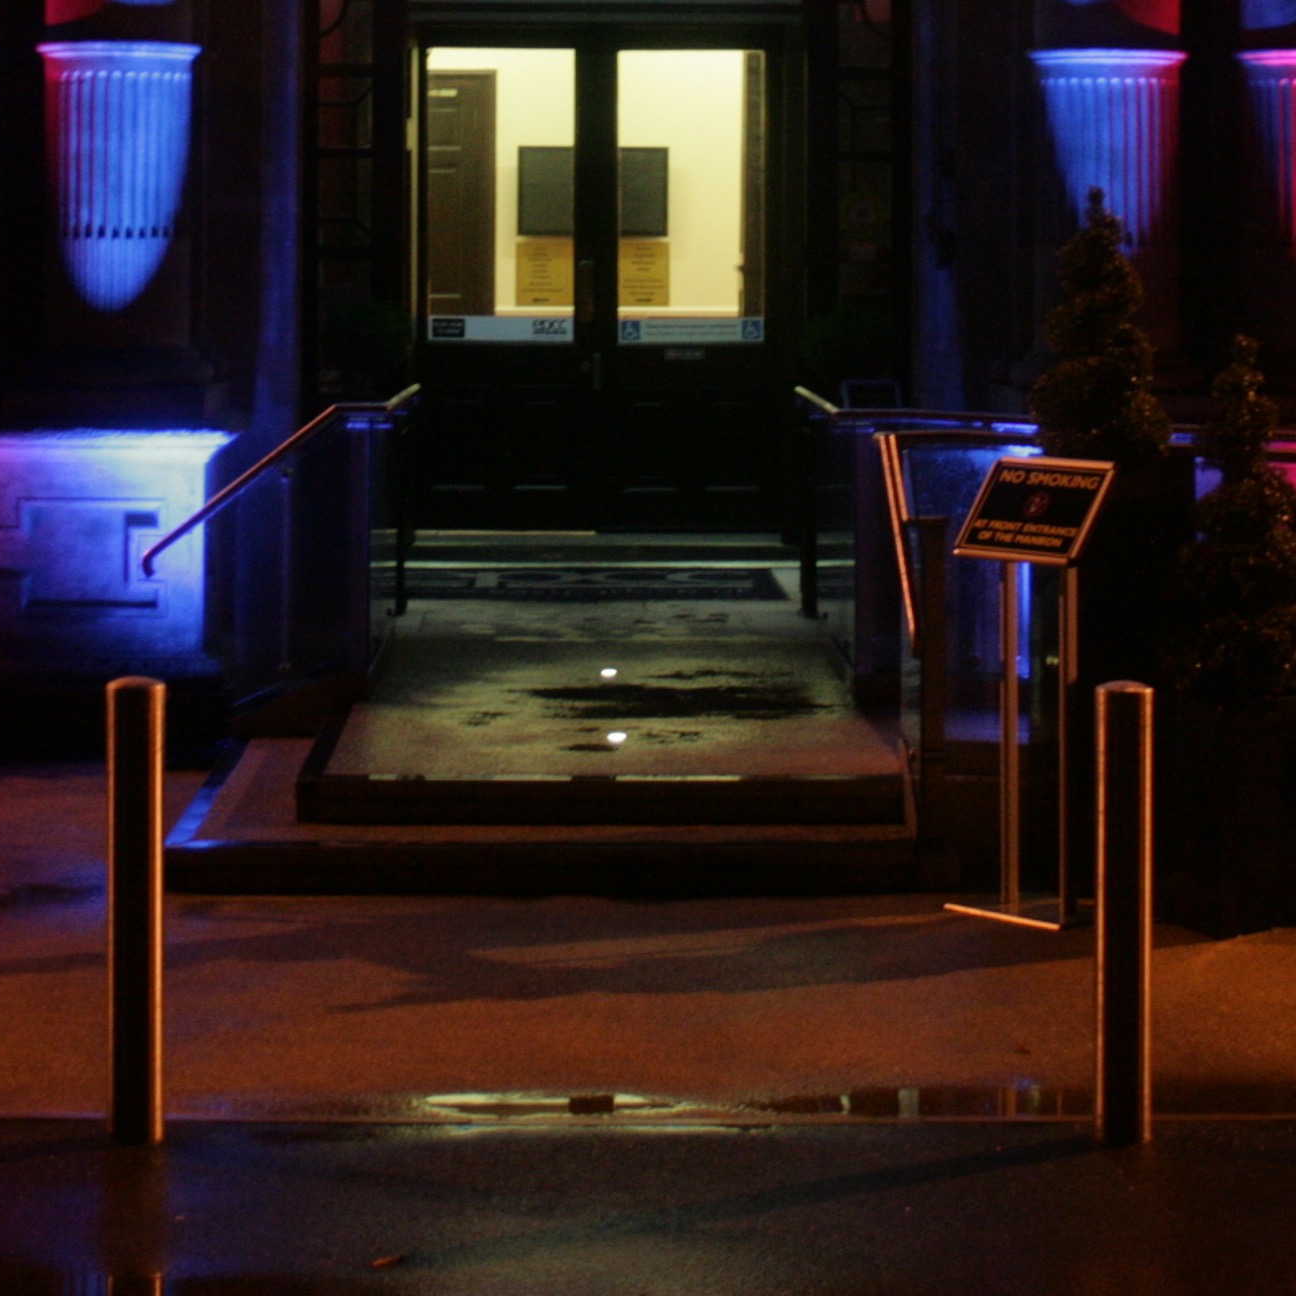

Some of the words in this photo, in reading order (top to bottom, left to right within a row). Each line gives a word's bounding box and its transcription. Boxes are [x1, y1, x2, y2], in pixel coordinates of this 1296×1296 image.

[998, 470, 1025, 484] NO
[1026, 472, 1100, 489] SMOKING
[977, 530, 993, 541] OF
[994, 531, 1015, 543] THE
[987, 519, 1024, 532] FRONT
[1022, 522, 1079, 537] ENTRANCE
